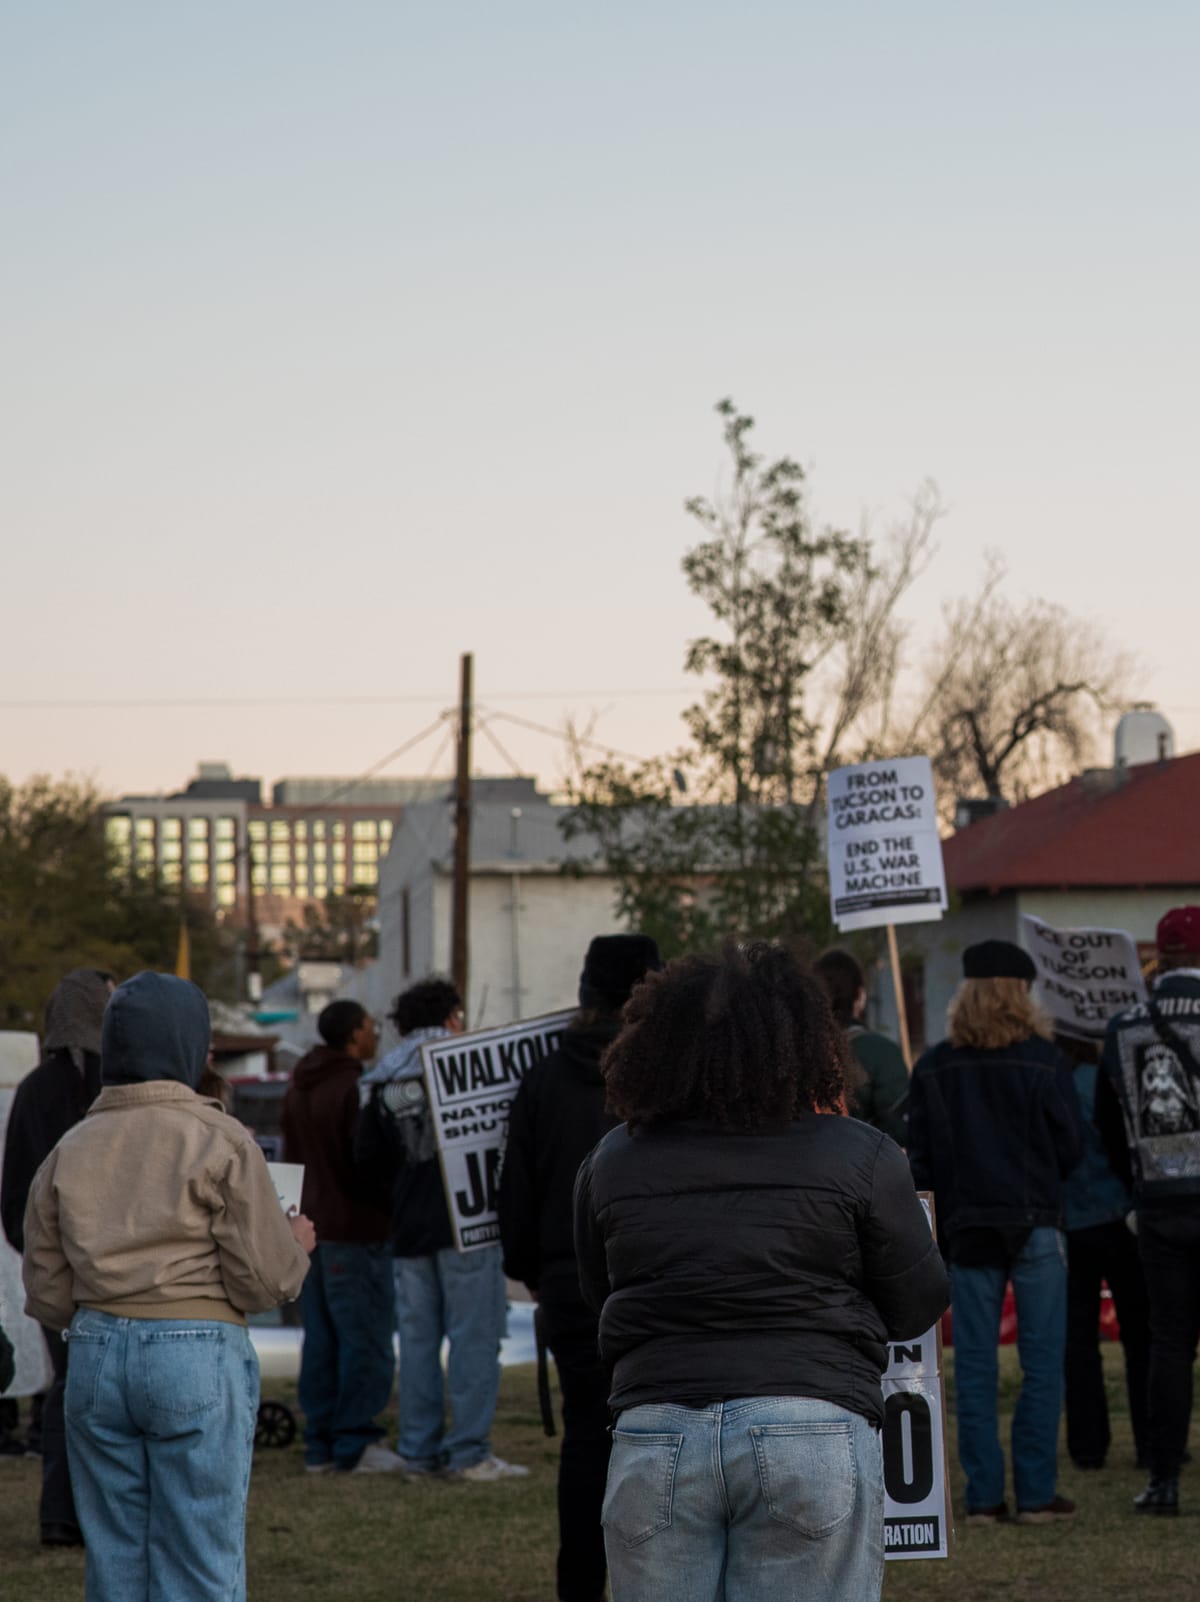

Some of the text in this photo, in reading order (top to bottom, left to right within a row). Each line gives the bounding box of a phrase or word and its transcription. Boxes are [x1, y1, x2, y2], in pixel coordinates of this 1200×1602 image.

[847, 769, 899, 790] FROM
[900, 785, 925, 800] TO
[846, 836, 913, 858] END THE
[878, 854, 920, 870] WAR
[845, 870, 922, 893] MACHINE
[1068, 935, 1113, 948] OUT
[1040, 953, 1127, 979] TUCSON
[1062, 950, 1091, 964] OF
